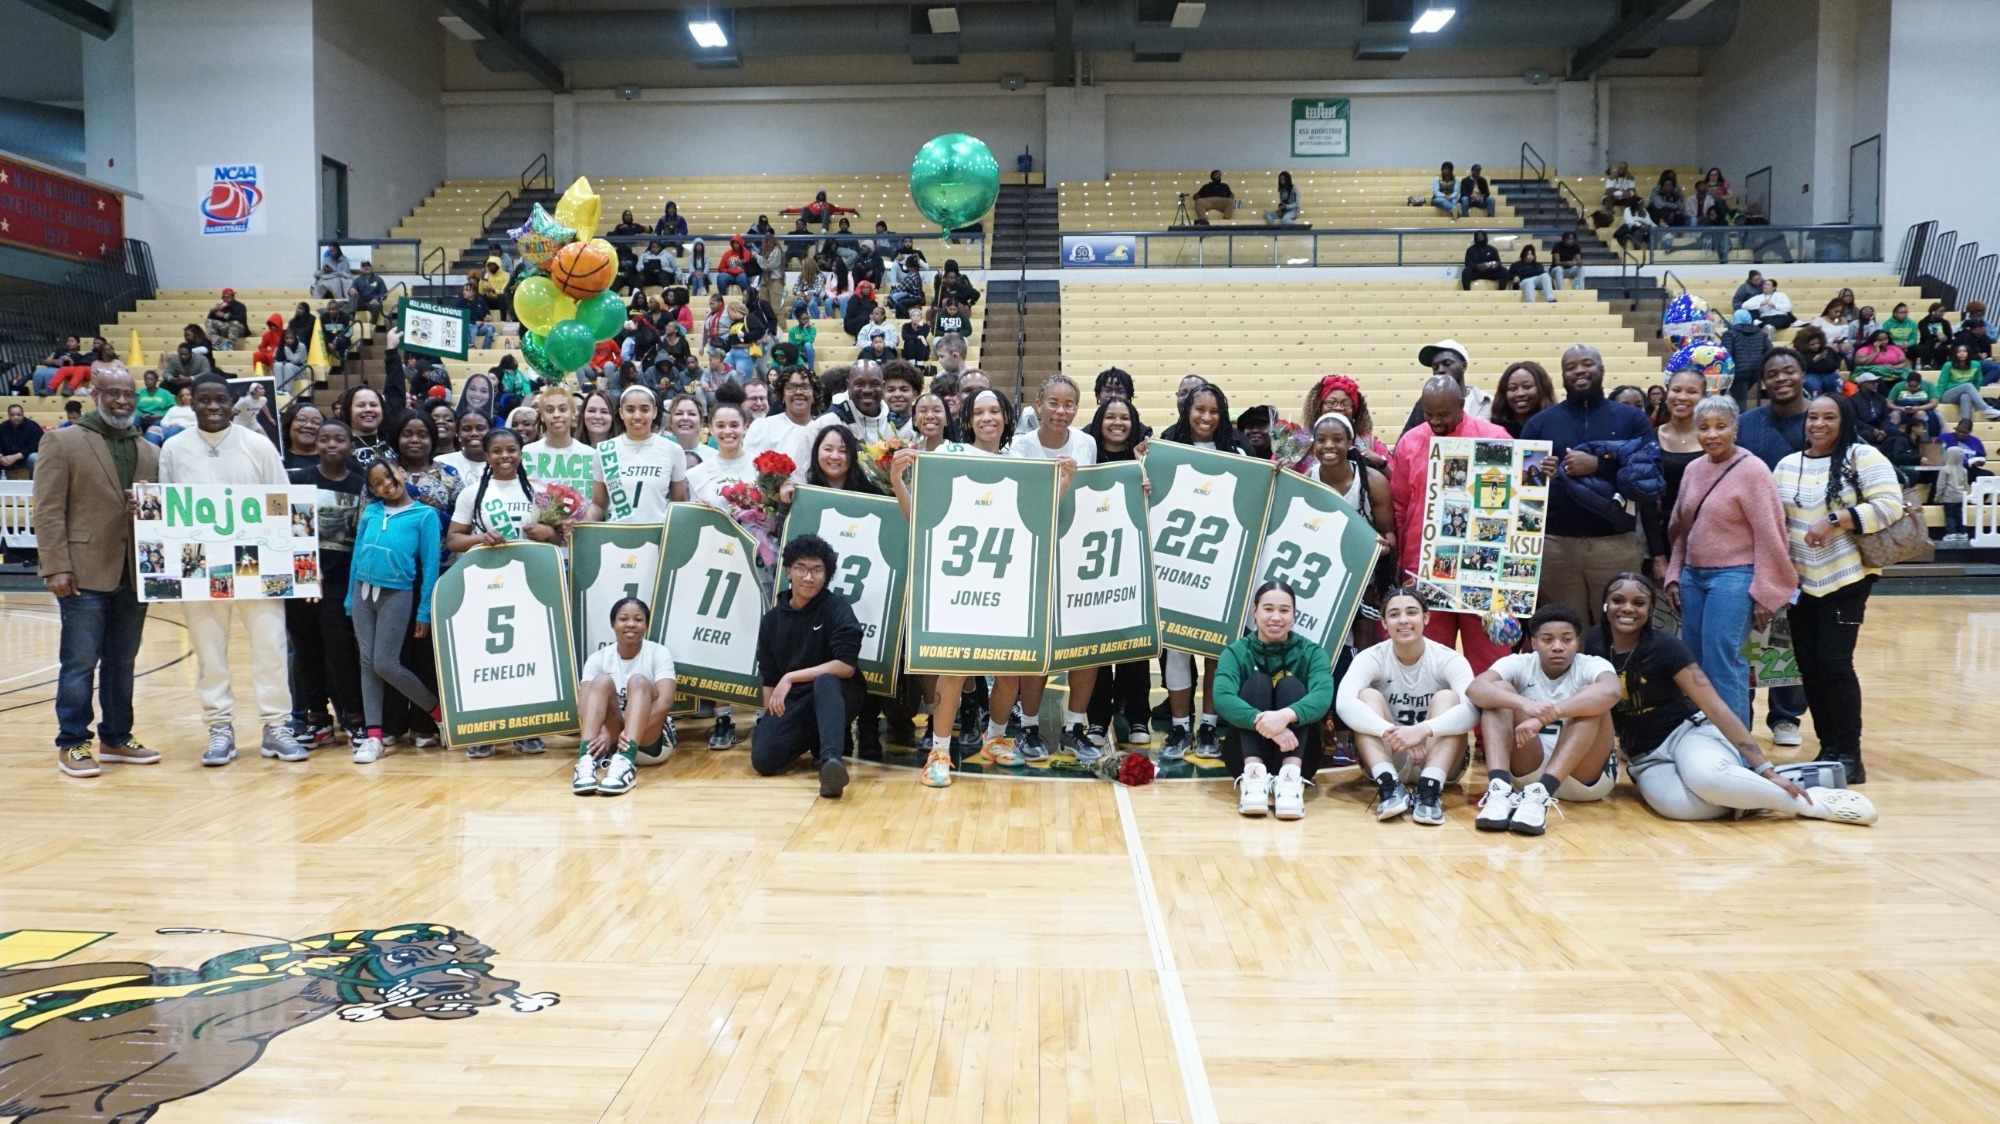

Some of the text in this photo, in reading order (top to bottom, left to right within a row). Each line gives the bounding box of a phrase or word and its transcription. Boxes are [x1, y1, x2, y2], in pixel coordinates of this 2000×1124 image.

[215, 165, 256, 180] NCAA
[13, 171, 92, 209] NAIA NATIONAL
[0, 192, 54, 222] SKETBALL
[205, 224, 246, 233] BASKETBALL
[1076, 248, 1088, 257] 50
[940, 317, 962, 328] KSU
[522, 452, 594, 479] GRACE
[620, 466, 662, 478] -STATE
[608, 480, 623, 492] 2024
[632, 481, 644, 508] 1
[1193, 487, 1212, 496] KSU
[166, 486, 262, 536] Naja
[840, 530, 857, 538] KSU
[1154, 508, 1230, 565] 22
[1302, 521, 1320, 532] KSU
[718, 548, 734, 556] KSU
[941, 525, 1015, 579] 34
[1077, 527, 1123, 581] 31
[1508, 535, 1542, 556] KSU
[620, 562, 637, 570] KSU
[1263, 540, 1332, 600] 23
[486, 582, 504, 590] KSU
[1154, 564, 1212, 590] THOMAS
[696, 568, 742, 620] 11
[950, 591, 1001, 607] JONES
[1066, 586, 1136, 609] THOMPSON
[484, 604, 515, 655] 5
[692, 626, 732, 646] KERR
[1167, 622, 1228, 646] BASKETBALL
[919, 645, 1037, 662] WOMEN'S BASKETBALL
[1054, 636, 1152, 660] WOMEN'S BASKETBALL
[472, 662, 536, 683] FENELON
[676, 674, 698, 687] EN'S
[700, 676, 758, 698] BASKETBALL
[1388, 692, 1434, 708] K-STAT
[457, 710, 571, 735] WOMEN'S BASKETBALL
